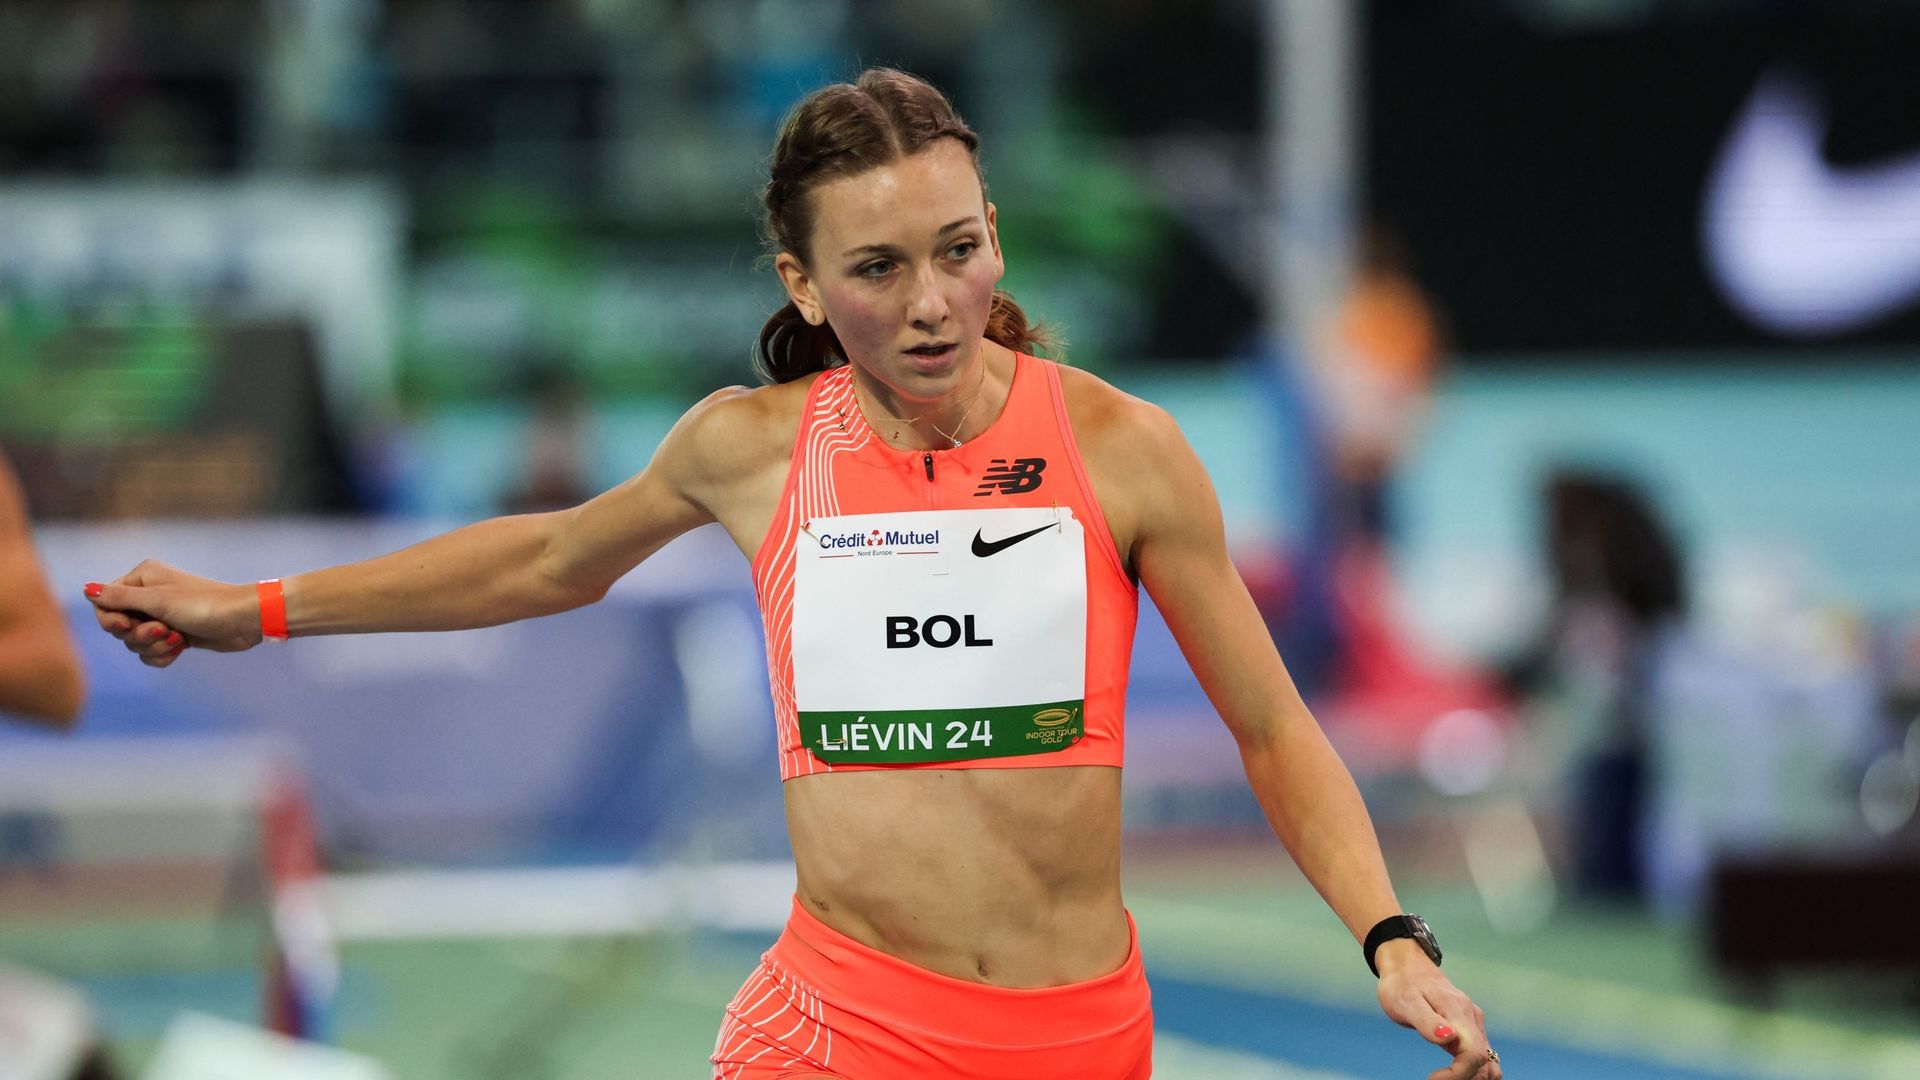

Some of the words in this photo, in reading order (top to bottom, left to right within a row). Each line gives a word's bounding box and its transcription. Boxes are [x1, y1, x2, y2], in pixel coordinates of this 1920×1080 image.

[819, 533, 866, 549] Crédit
[885, 530, 939, 546] Mutuel
[886, 614, 994, 649] BOL
[820, 715, 933, 751] LIÉVIN
[945, 720, 993, 749] 24
[1025, 730, 1056, 740] INDOOR
[1057, 727, 1078, 737] TOUR
[1040, 736, 1063, 745] GOLD
